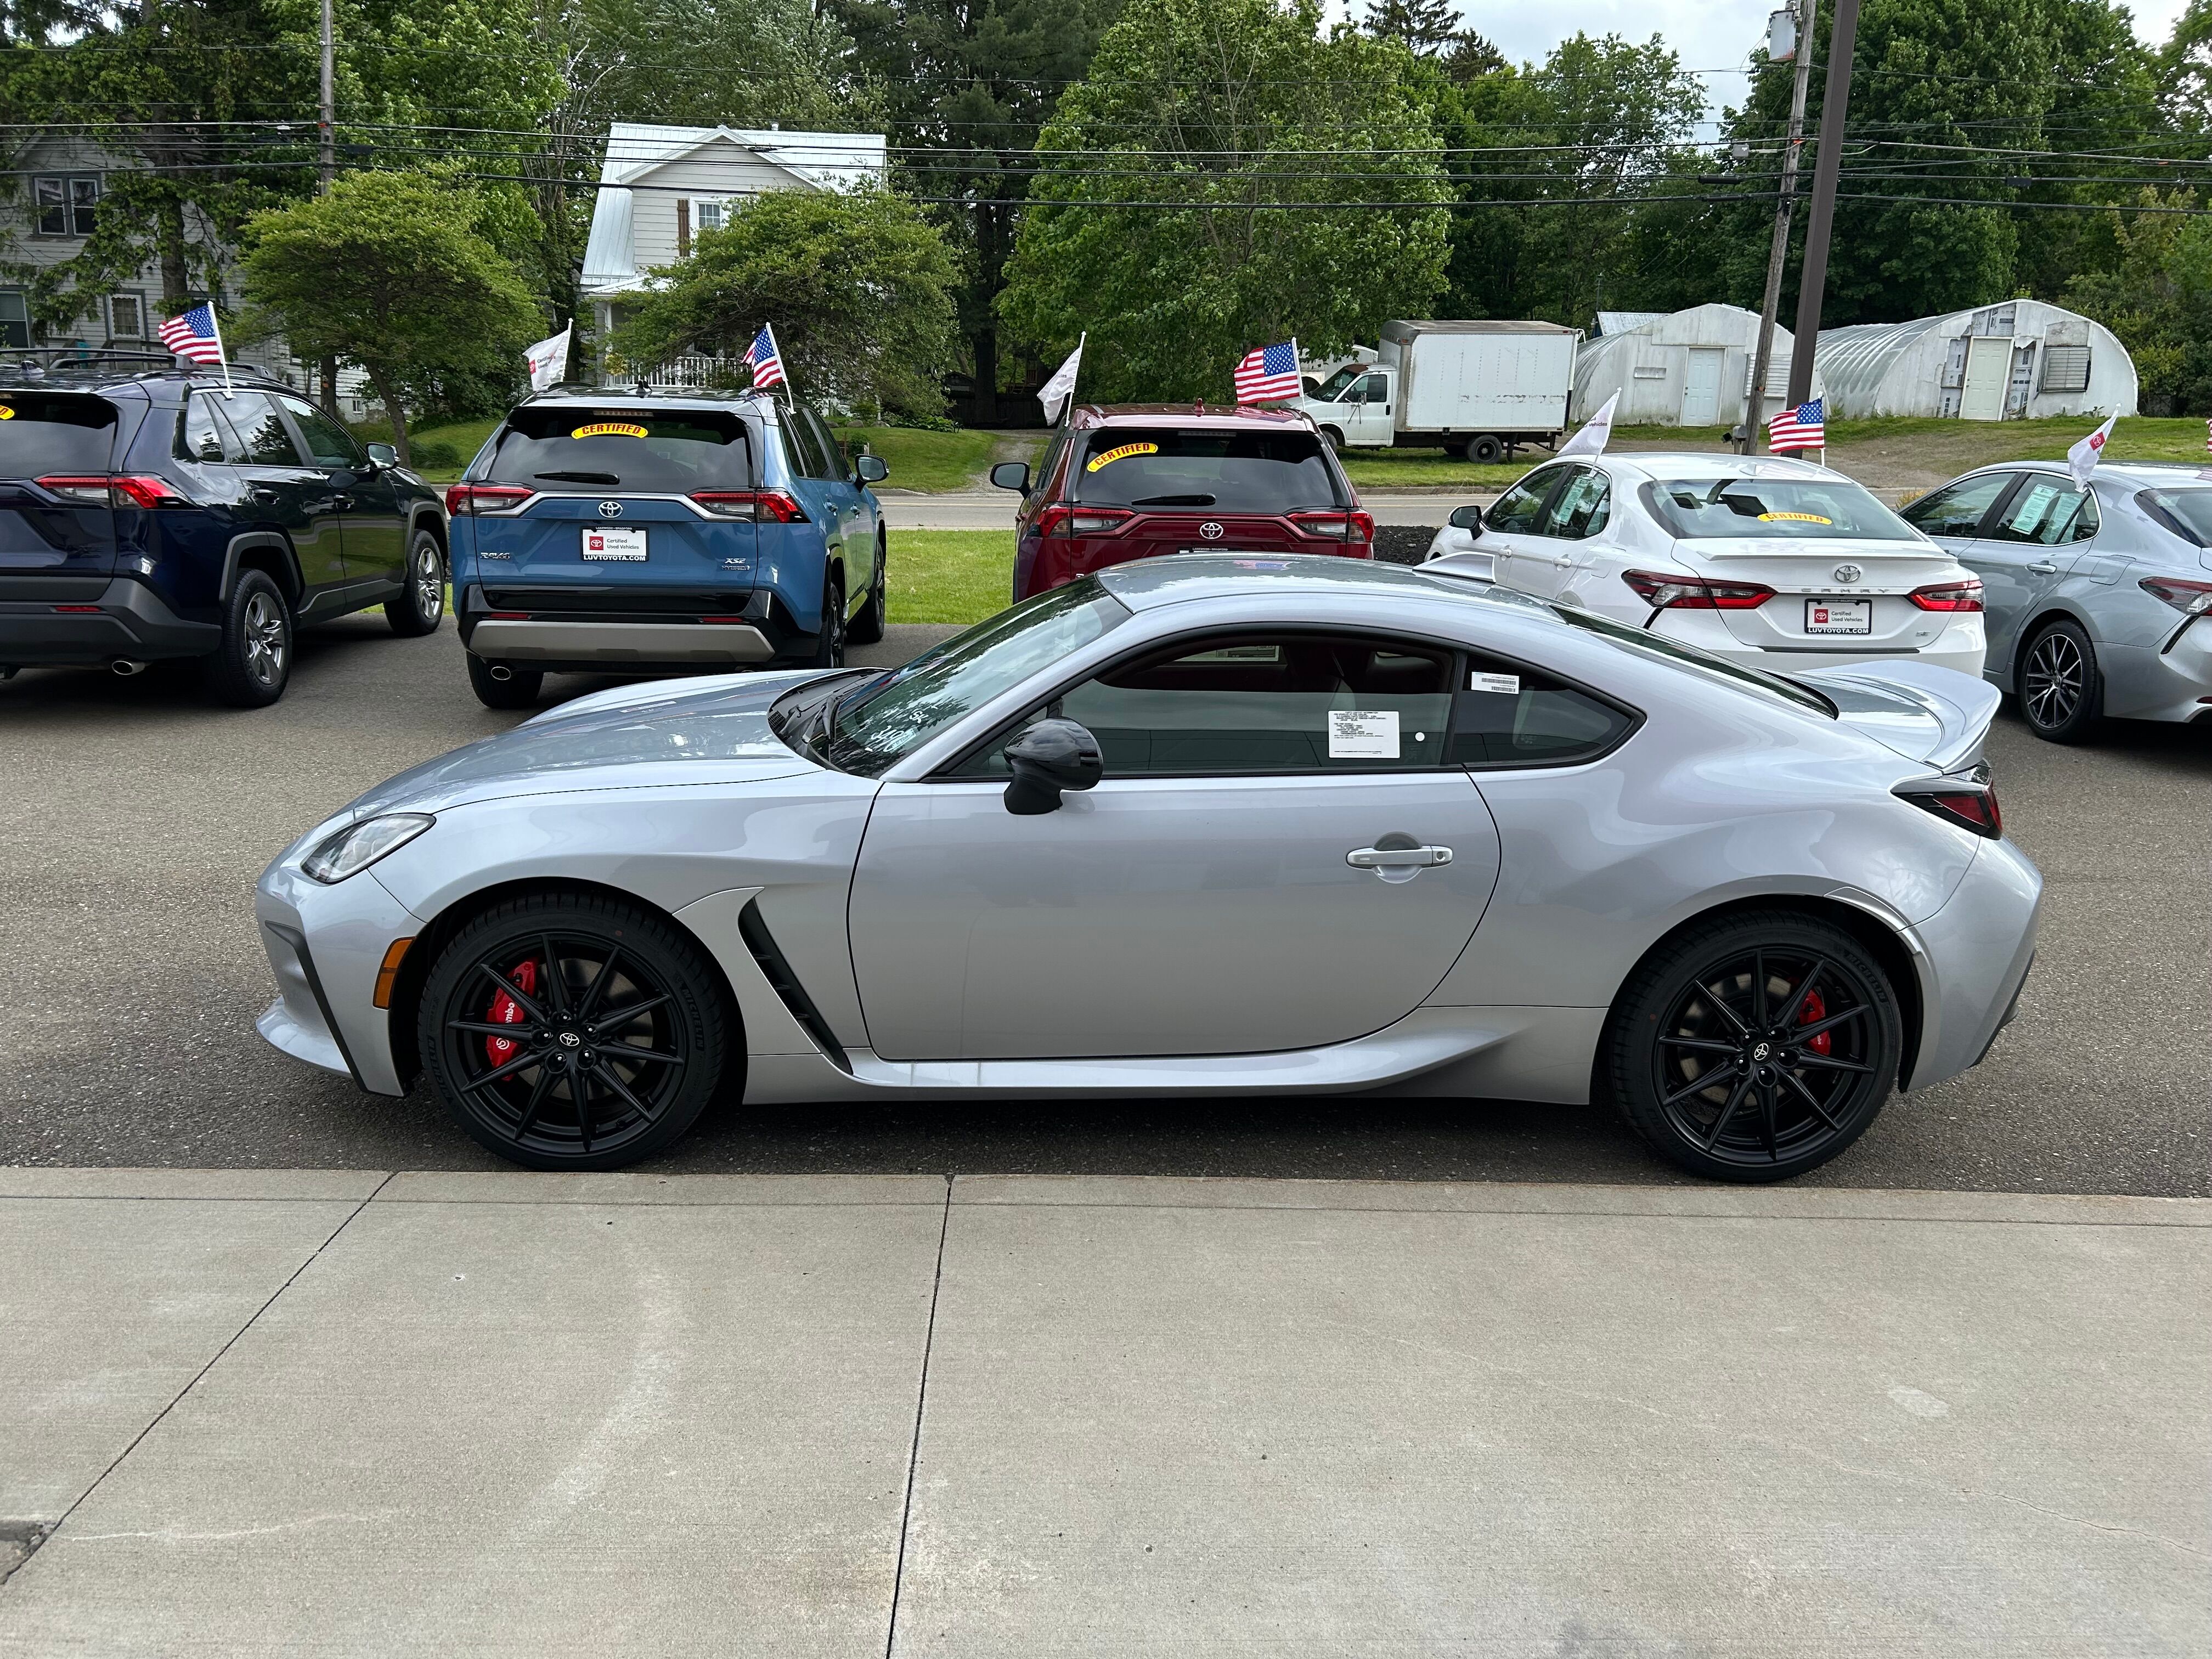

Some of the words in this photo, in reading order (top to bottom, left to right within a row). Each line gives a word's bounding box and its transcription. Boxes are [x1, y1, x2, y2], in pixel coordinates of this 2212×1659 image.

[582, 424, 641, 435] CERTIFIED
[1094, 443, 1150, 466] CERTIFIED
[1765, 514, 1823, 522] CERTIFIED
[1847, 953, 1887, 1002] MICHELIN
[682, 988, 704, 1049] MICHELIN
